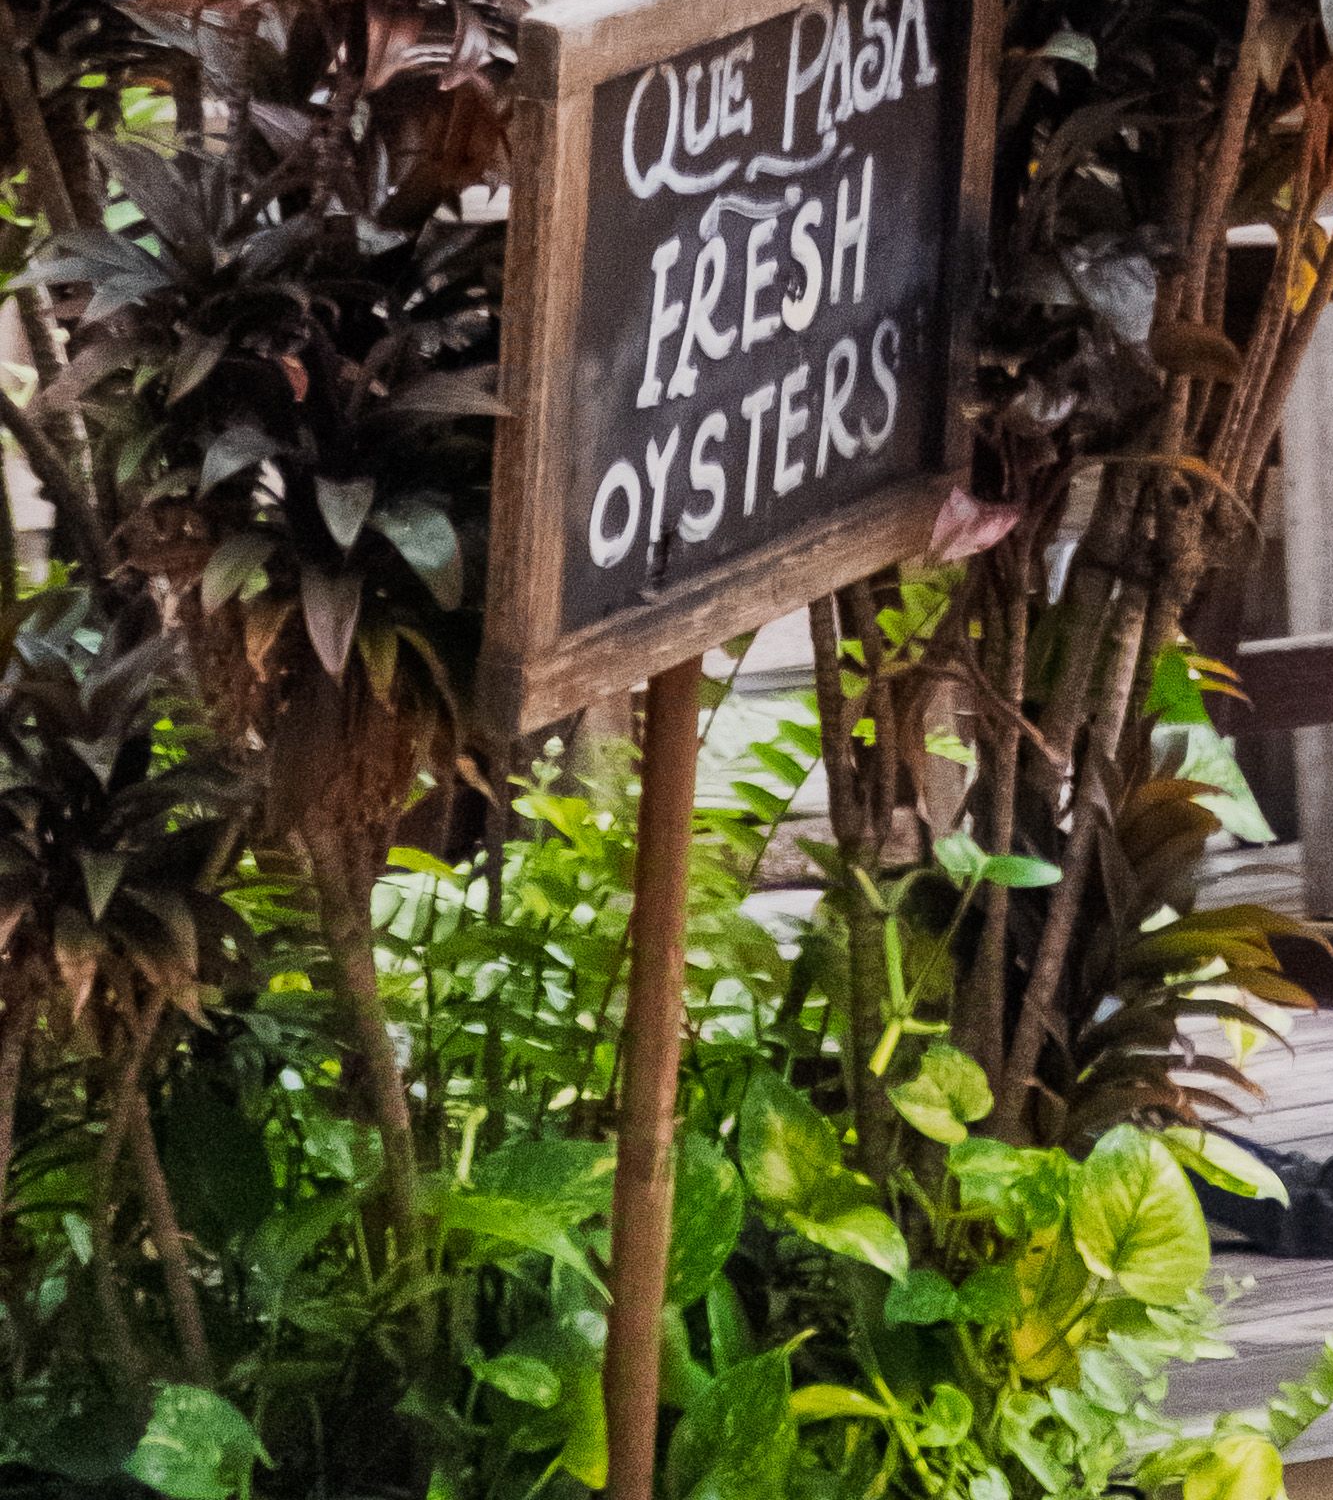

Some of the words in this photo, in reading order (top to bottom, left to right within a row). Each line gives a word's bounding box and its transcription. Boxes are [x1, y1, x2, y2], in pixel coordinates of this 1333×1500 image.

[622, 34, 754, 199] QUE
[636, 155, 875, 408] FRESH
[588, 317, 900, 569] OYSTERS
